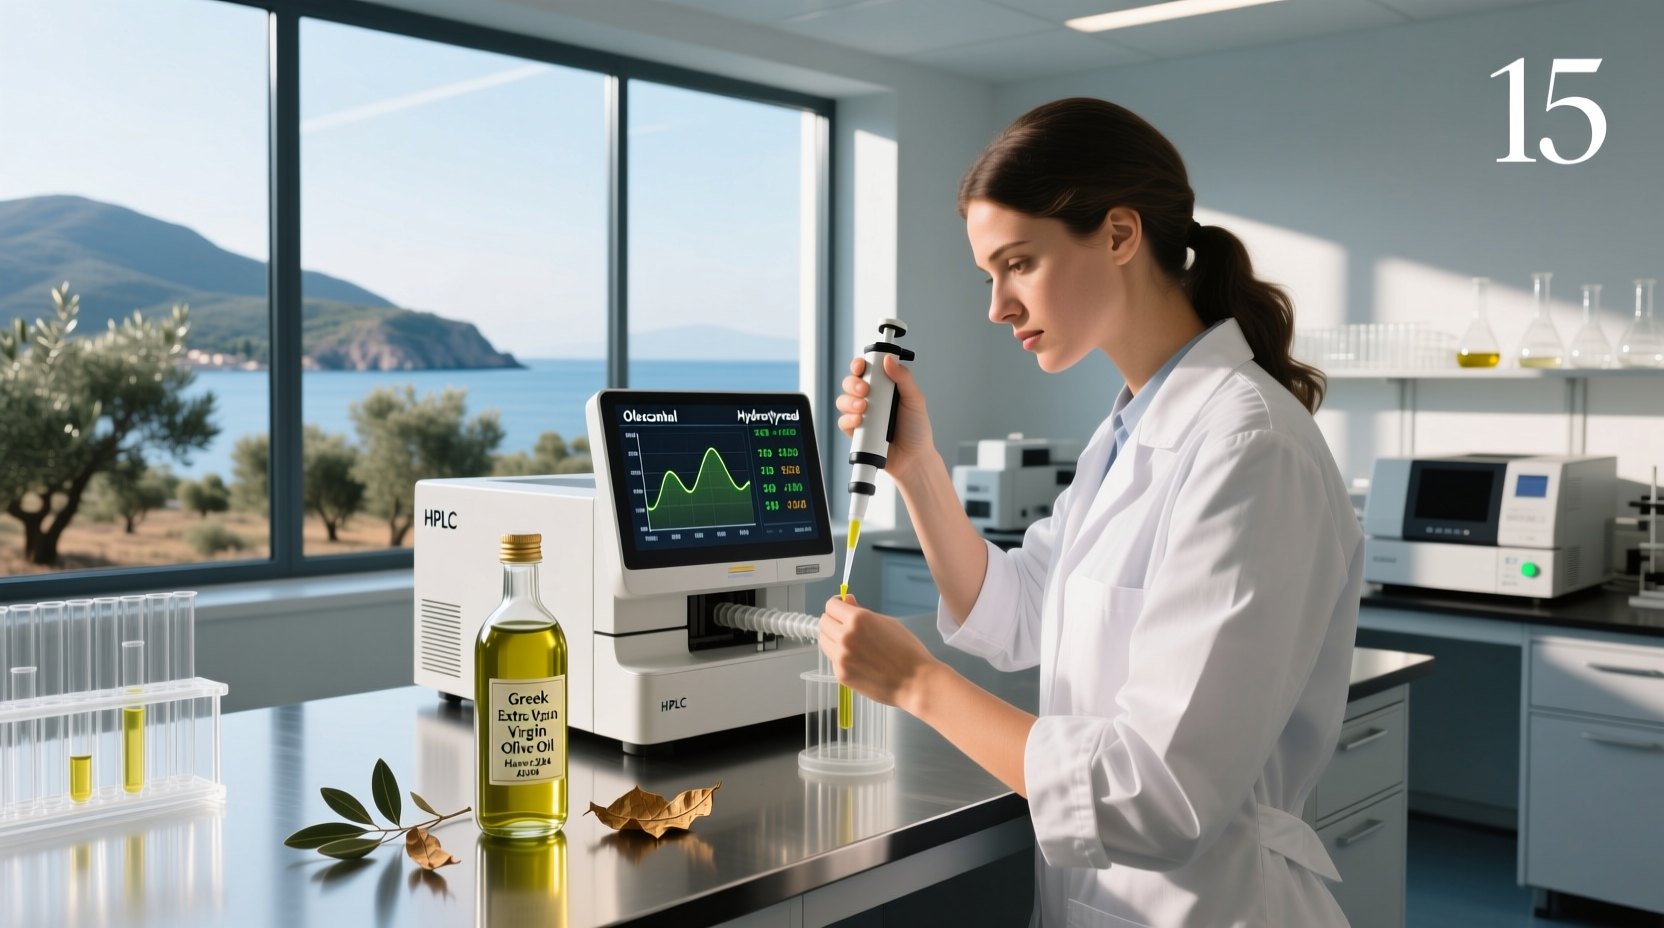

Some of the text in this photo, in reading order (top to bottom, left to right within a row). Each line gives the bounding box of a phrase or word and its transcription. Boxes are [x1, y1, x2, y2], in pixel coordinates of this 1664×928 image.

[424, 508, 458, 530] HPLC
[508, 690, 549, 706] Greek
[661, 697, 687, 713] HPLC
[508, 724, 547, 741] Virgin
